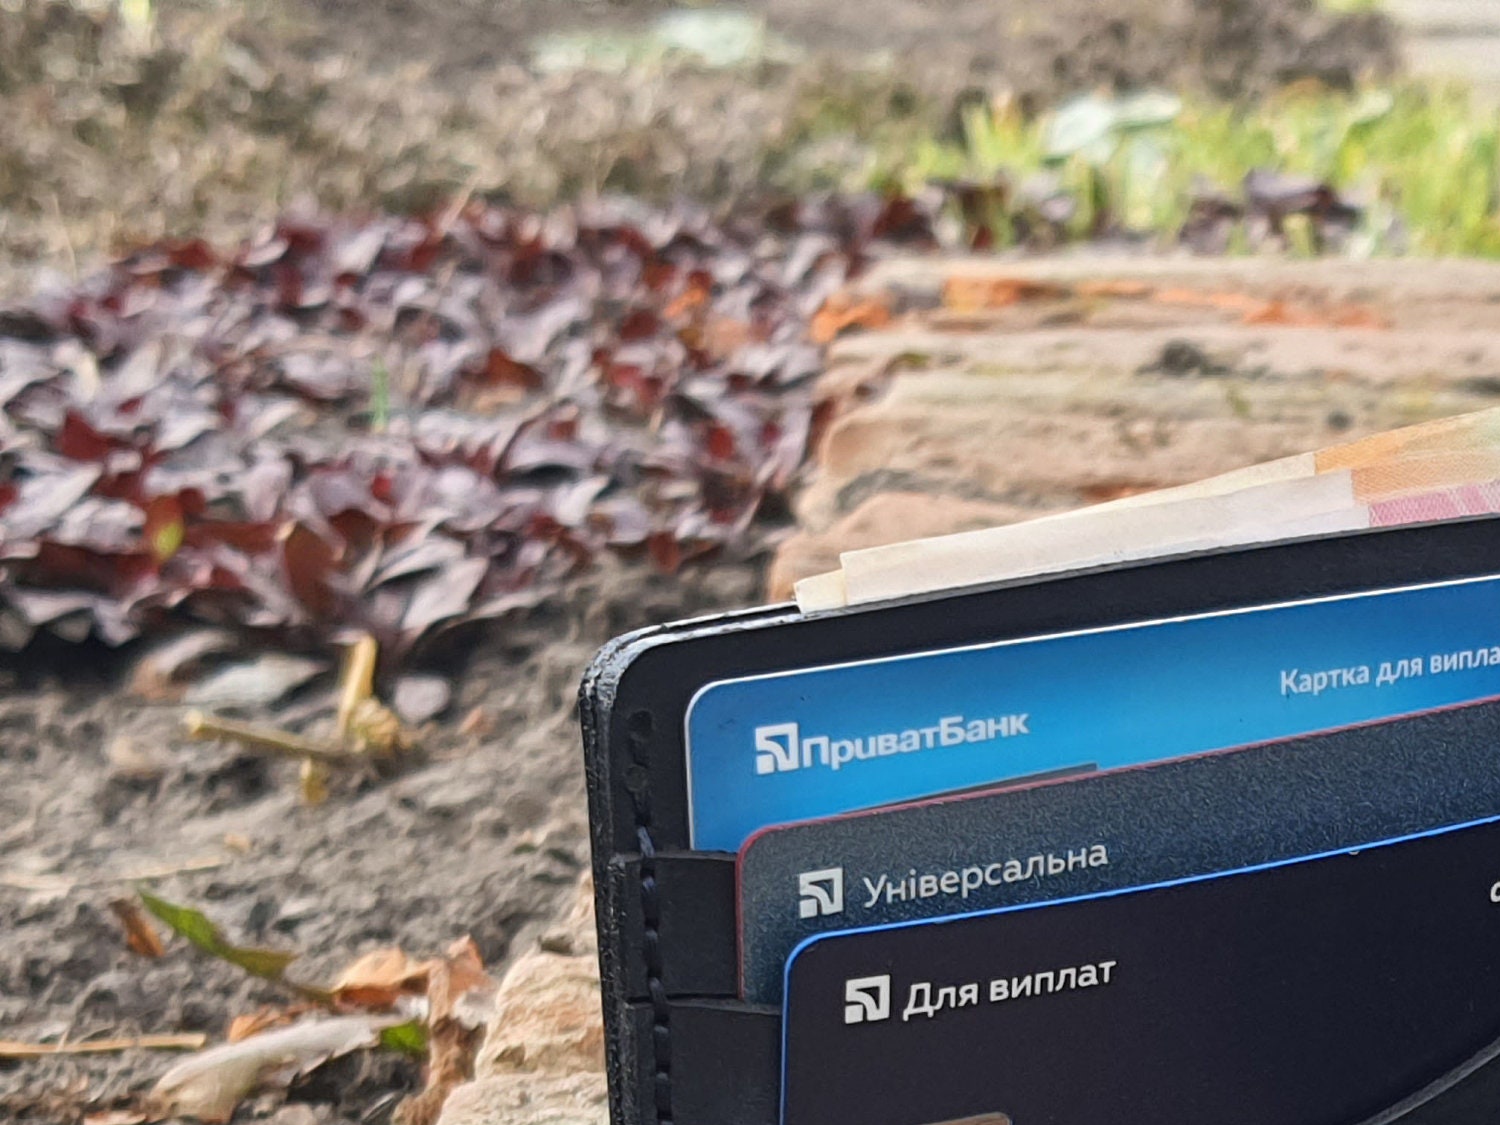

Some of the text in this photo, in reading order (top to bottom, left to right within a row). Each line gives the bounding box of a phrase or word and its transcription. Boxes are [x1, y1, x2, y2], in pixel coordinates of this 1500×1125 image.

[1280, 664, 1370, 696] Картка
[1376, 656, 1423, 688] для
[802, 713, 1030, 771] ПриватБанк
[862, 843, 1109, 909] Універсальна
[902, 960, 1117, 1022] Для виплат
